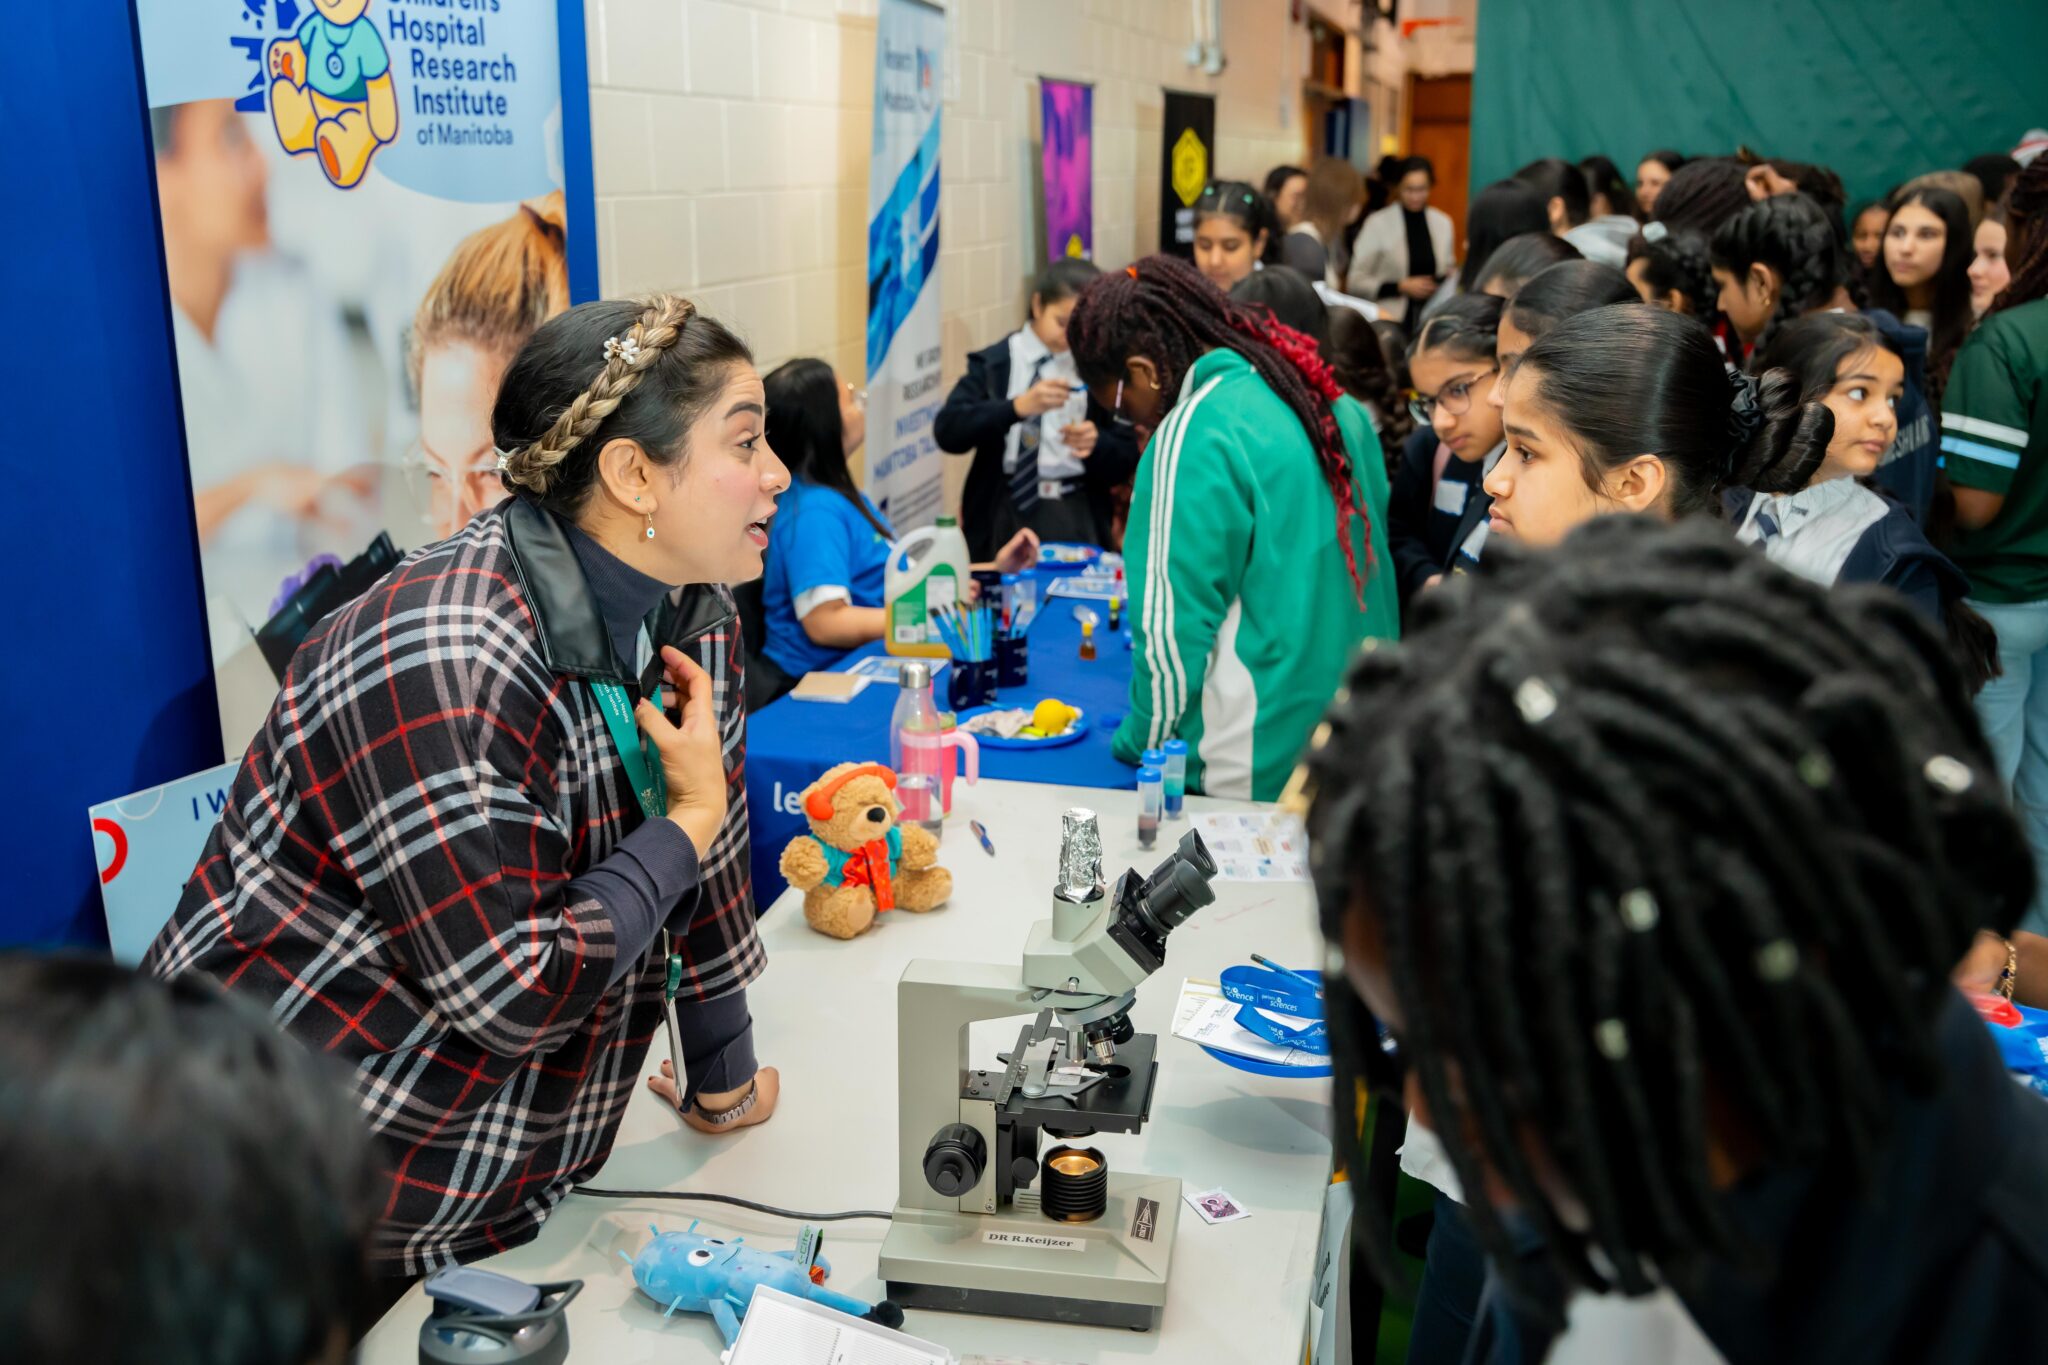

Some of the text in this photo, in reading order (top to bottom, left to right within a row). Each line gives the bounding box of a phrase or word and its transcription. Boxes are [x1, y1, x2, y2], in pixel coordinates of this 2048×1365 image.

[388, 9, 486, 51] Hospital
[410, 48, 517, 82] Research
[413, 84, 508, 116] Institute
[416, 122, 514, 146] of Manitoba
[192, 797, 199, 821] I
[988, 1233, 1074, 1247] DR R.Keijzer
